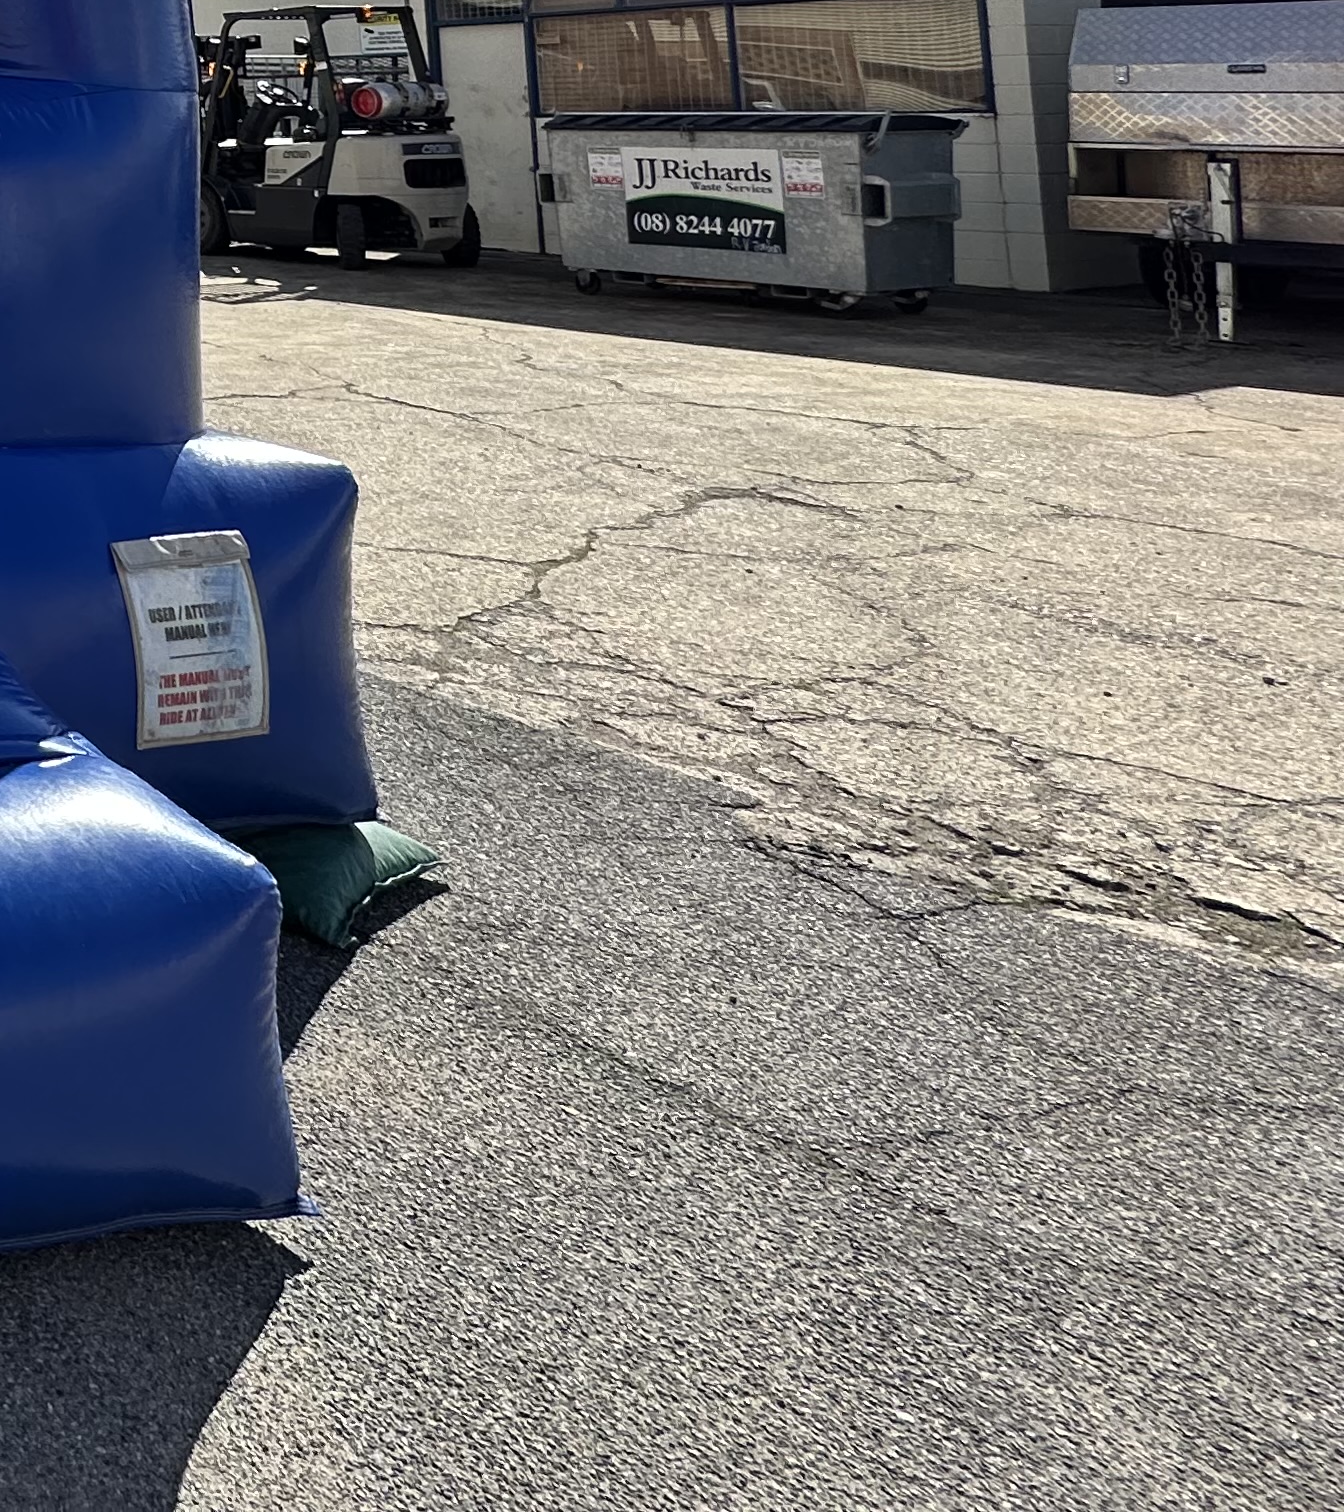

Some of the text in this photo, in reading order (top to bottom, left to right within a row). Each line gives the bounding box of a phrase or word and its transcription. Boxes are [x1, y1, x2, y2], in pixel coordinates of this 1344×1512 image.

[632, 158, 657, 189] JJ
[662, 159, 772, 182] Richards
[690, 181, 773, 194] Waste Services
[633, 211, 776, 238] (08) 8244 4077
[148, 606, 176, 623] USER
[164, 623, 207, 642] MANUAL
[159, 674, 176, 689] THE
[179, 670, 220, 687] MANUAL
[158, 691, 197, 708] REMAIN
[159, 710, 184, 726] RIDE
[185, 708, 199, 724] AT
